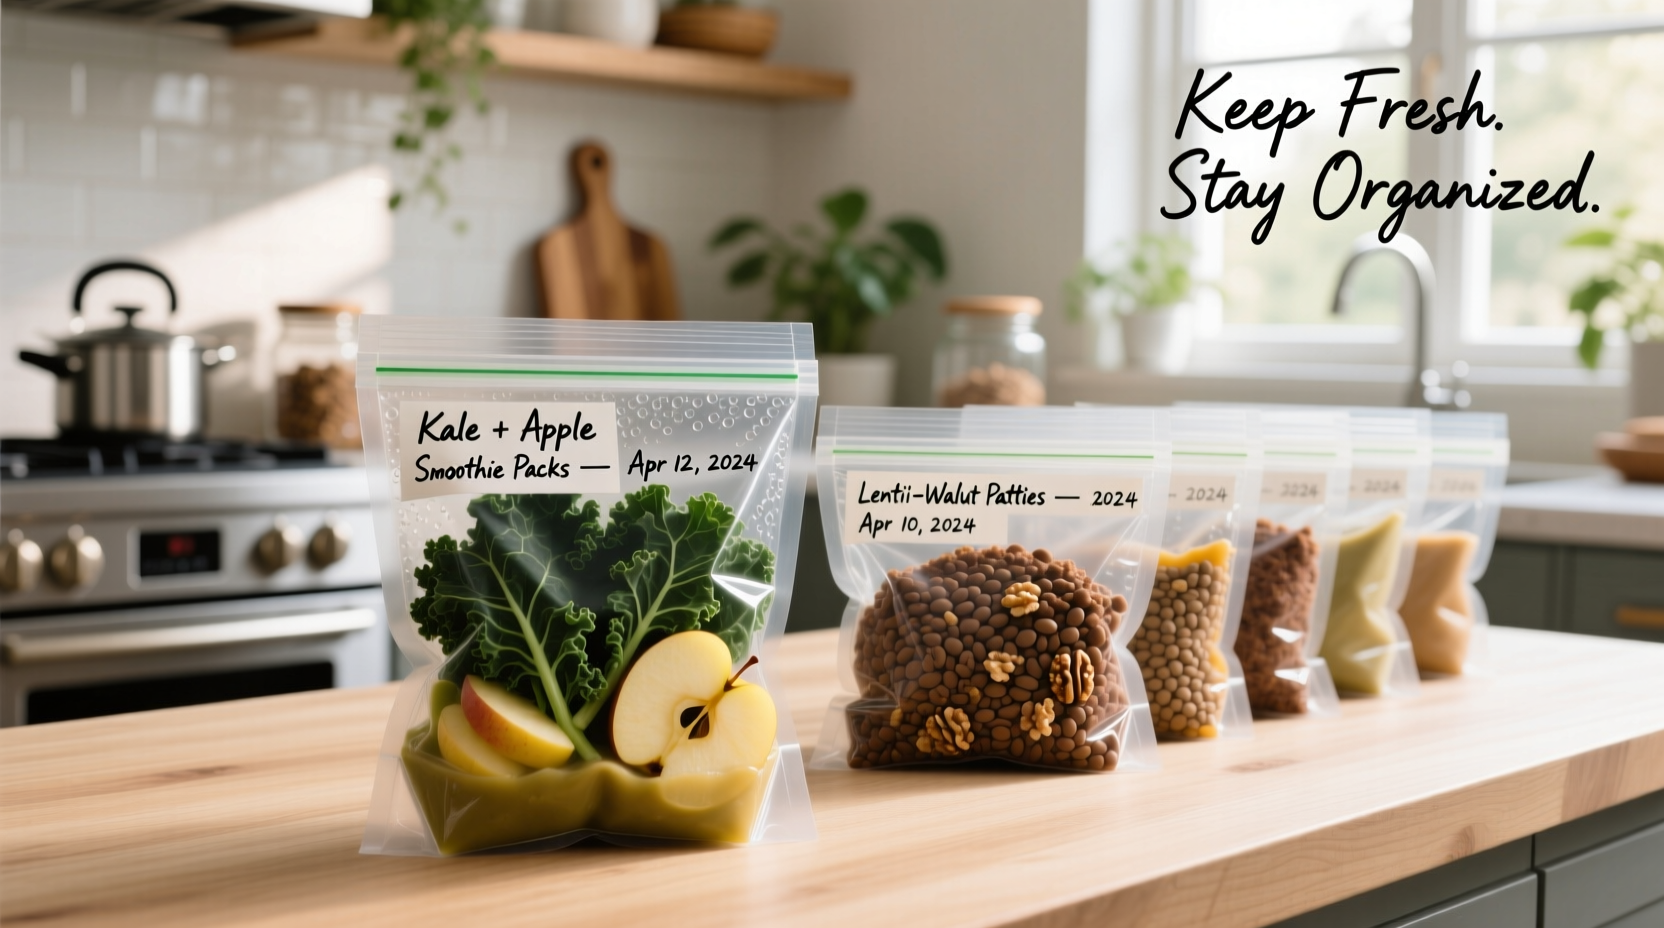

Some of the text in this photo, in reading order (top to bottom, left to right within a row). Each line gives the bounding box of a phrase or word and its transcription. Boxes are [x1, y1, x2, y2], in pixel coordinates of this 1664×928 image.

[417, 407, 597, 452] Kale + Apple
[414, 453, 505, 482] Smoothie
[513, 453, 570, 480] Packs
[627, 448, 668, 482] Apr
[674, 454, 700, 476] 12,
[707, 453, 759, 472] 2024
[985, 482, 1046, 507] Patties
[1091, 490, 1138, 509] 2024
[1185, 486, 1228, 502] 2024
[858, 511, 977, 539] Apr 10, 2024
